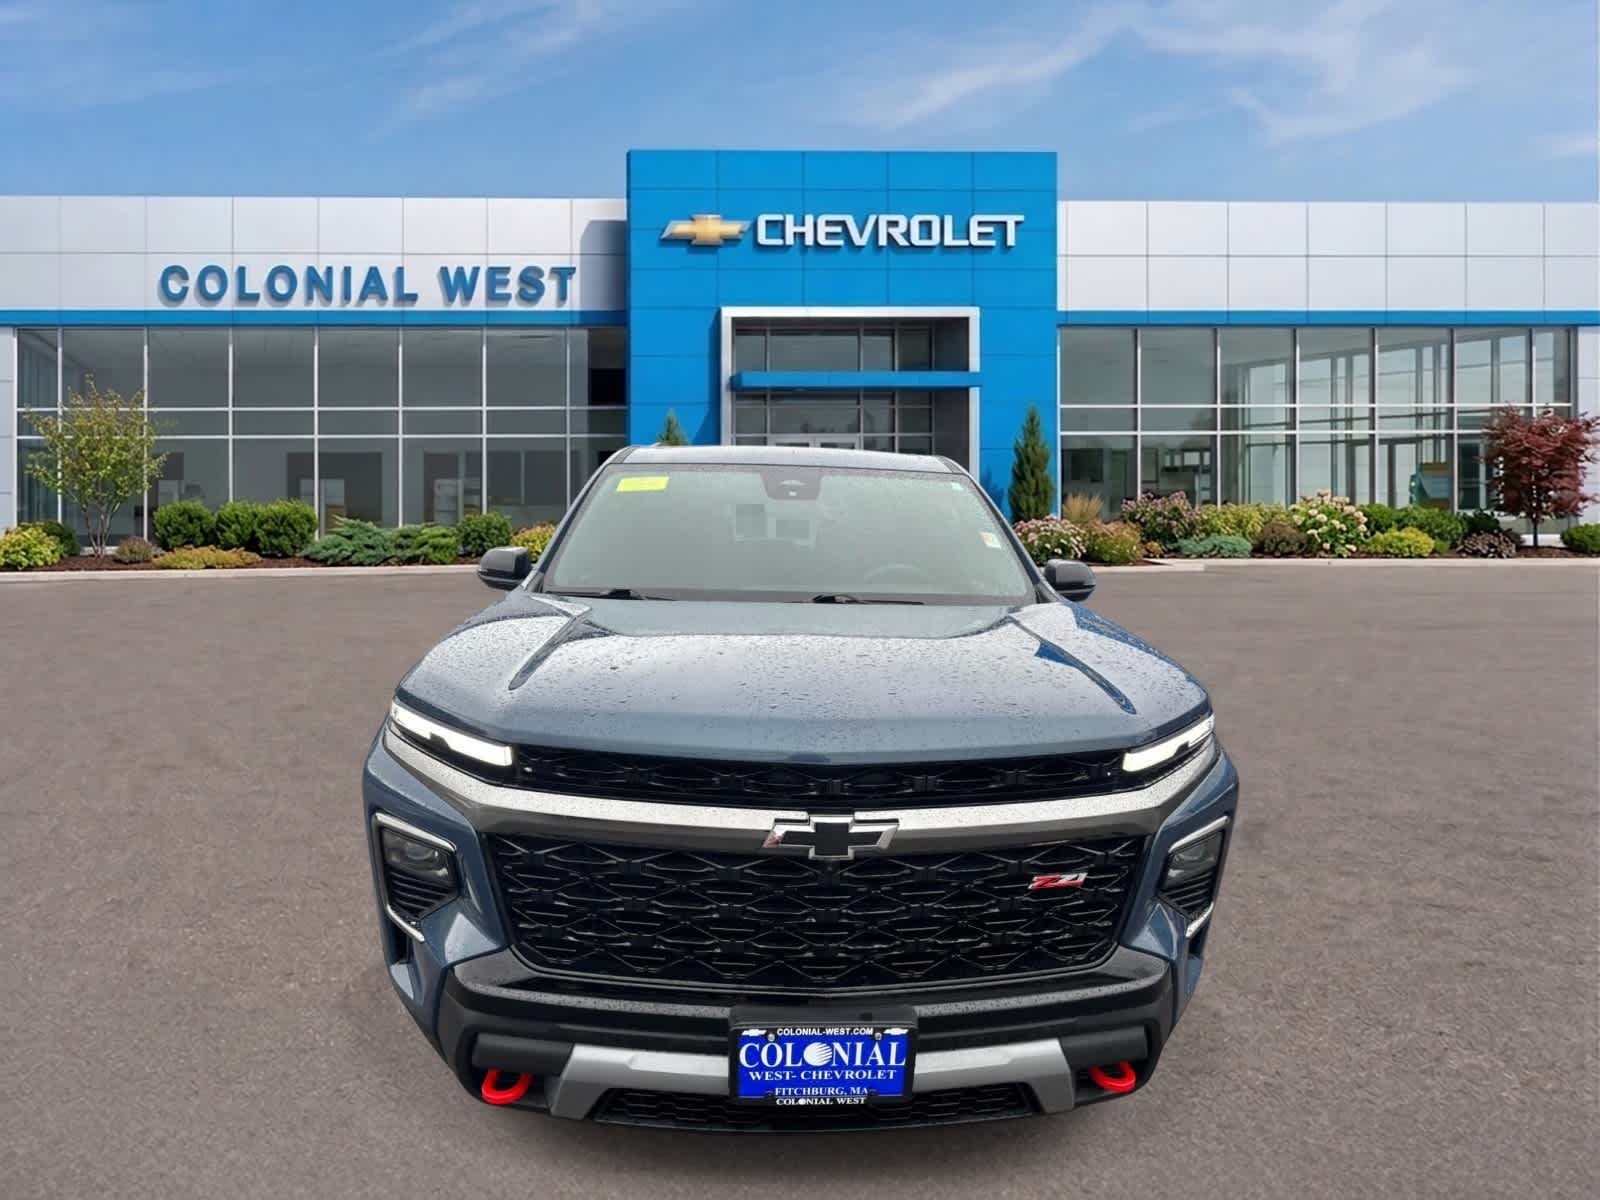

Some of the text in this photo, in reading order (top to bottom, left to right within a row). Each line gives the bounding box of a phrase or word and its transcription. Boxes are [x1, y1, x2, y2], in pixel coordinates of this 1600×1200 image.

[756, 213, 1025, 248] CHEVROLET
[160, 264, 577, 304] COLONIAL WEST
[776, 1028, 874, 1036] COLONIAL-WEST.COM
[738, 1041, 906, 1068] COLONIAL
[800, 1069, 897, 1080] CHEVROLET
[850, 1086, 868, 1095] MA
[776, 1097, 866, 1106] COLONIAL WEST
